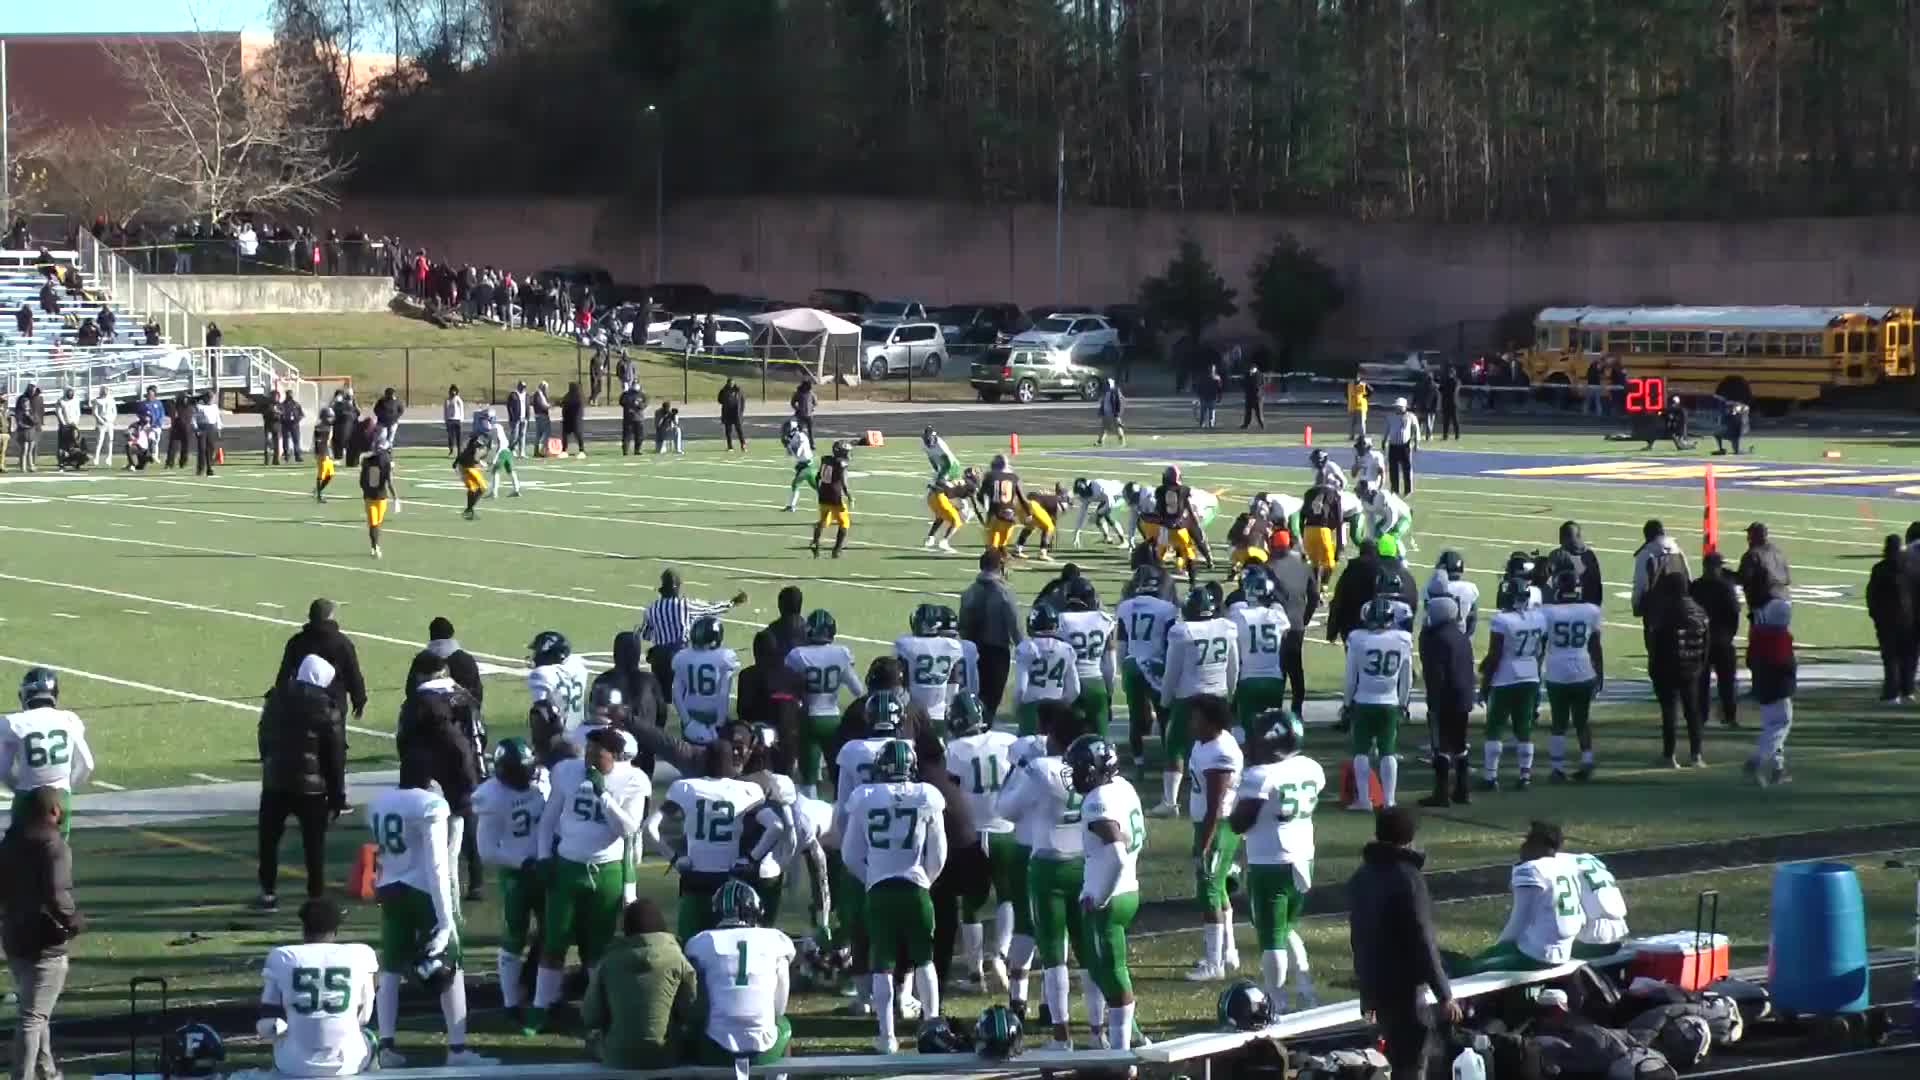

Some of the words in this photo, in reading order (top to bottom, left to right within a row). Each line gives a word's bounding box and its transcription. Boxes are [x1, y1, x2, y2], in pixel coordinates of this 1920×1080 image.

[1626, 378, 1663, 411] 20
[1131, 612, 1155, 642] 17
[1249, 623, 1279, 654] 15
[1553, 621, 1587, 649] 58
[1193, 636, 1229, 666] 72
[1363, 649, 1401, 677] 30
[687, 663, 717, 696] 16
[1029, 657, 1066, 688] 24
[23, 729, 70, 769] 62
[971, 753, 999, 794] 11
[371, 812, 408, 855] 18
[694, 798, 735, 843] 12
[866, 807, 919, 850] 27
[735, 939, 750, 987] 1
[291, 966, 352, 1015] 55
